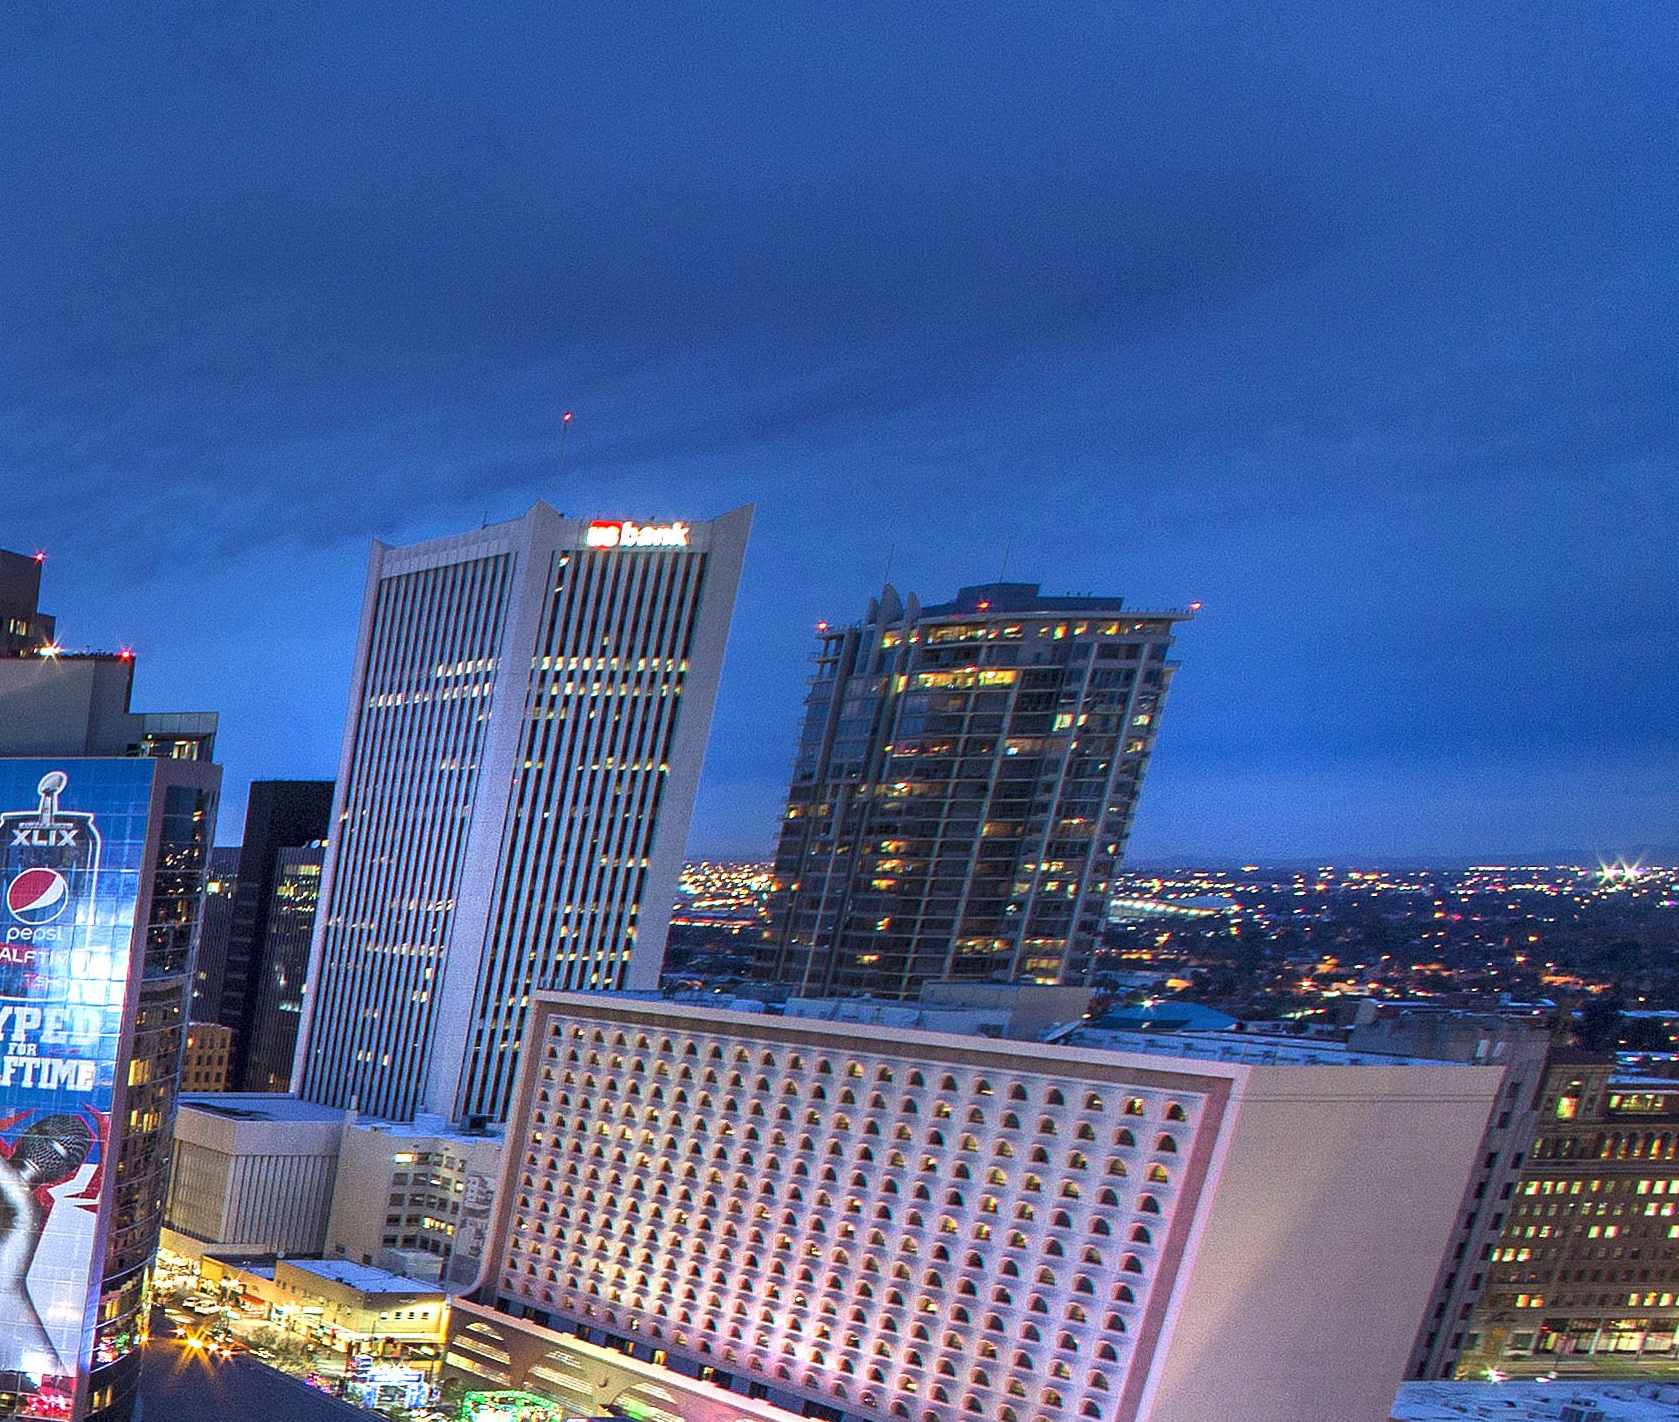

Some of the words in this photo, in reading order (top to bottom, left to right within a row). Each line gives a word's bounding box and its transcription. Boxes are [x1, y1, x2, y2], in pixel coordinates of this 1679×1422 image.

[10, 829, 78, 847] XLIX
[6, 926, 61, 944] pepsi
[8, 1041, 38, 1056] FOR
